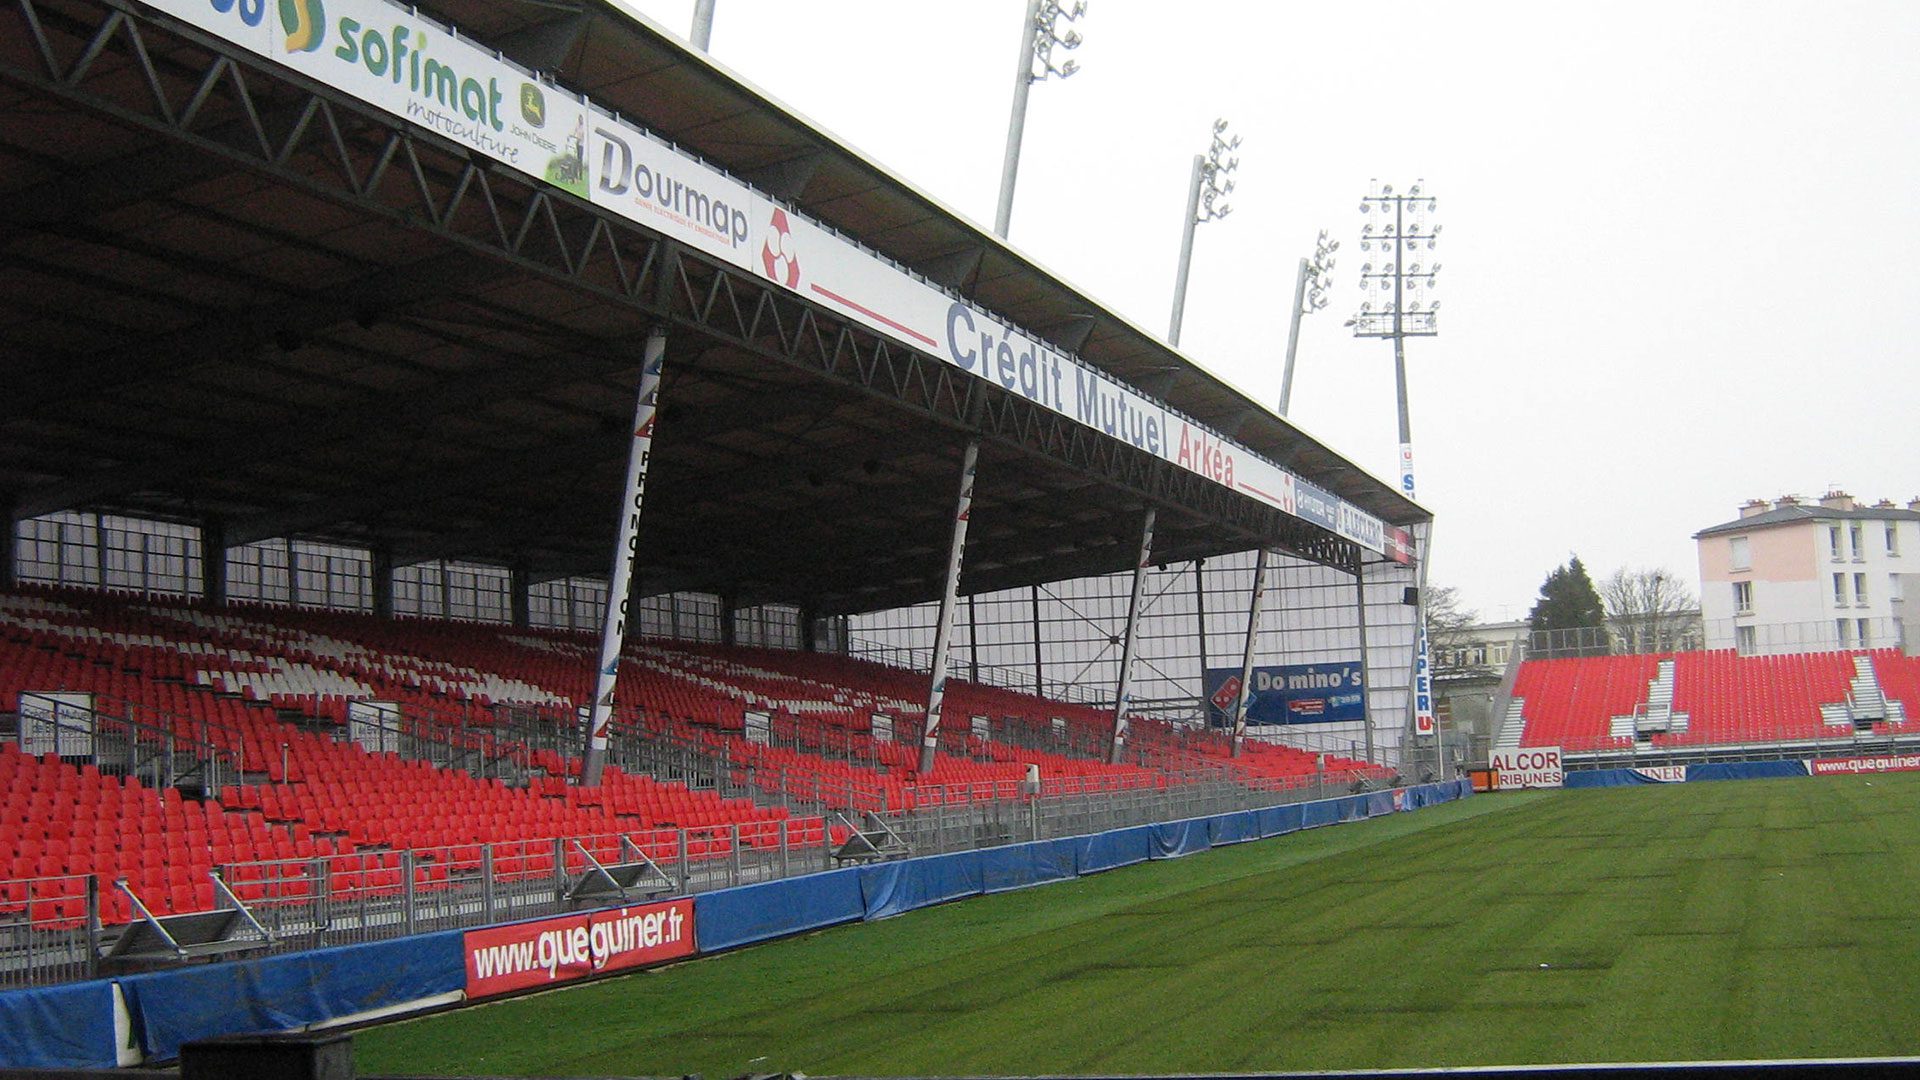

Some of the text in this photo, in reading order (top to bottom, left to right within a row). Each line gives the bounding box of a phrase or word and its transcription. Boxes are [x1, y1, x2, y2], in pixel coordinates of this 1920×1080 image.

[335, 16, 503, 132] sofimat
[407, 98, 518, 163] motoculture
[594, 126, 748, 248] Dourmap
[946, 301, 1234, 489] Crédit Mutuel Arkéa
[1257, 667, 1362, 691] Domino's
[1492, 752, 1560, 771] ALCOR
[1499, 771, 1561, 785] RIBUNES
[474, 906, 684, 980] www.queguiner.fr
